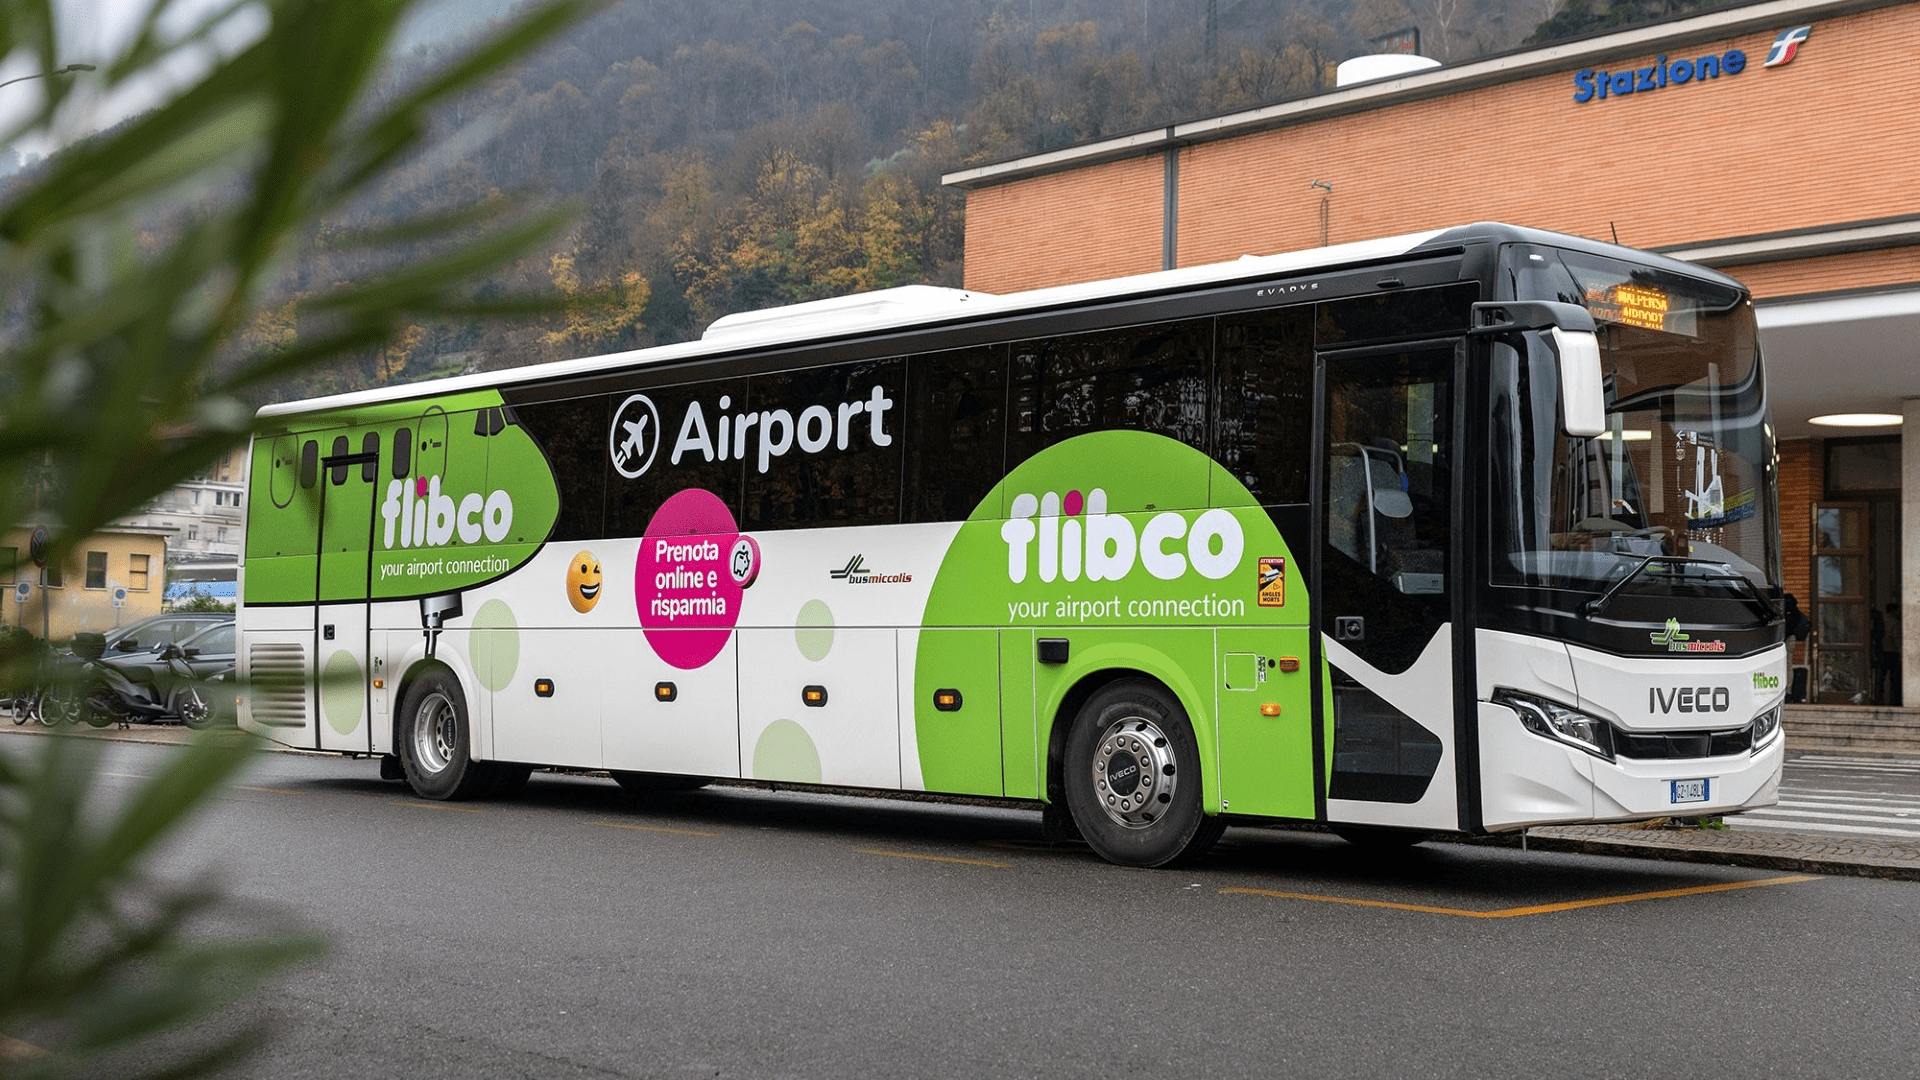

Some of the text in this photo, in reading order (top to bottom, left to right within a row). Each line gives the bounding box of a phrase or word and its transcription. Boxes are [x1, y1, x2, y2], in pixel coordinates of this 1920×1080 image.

[1573, 50, 1747, 103] Stazione
[671, 385, 893, 474] Airport
[381, 474, 513, 549] flibco
[1000, 488, 1245, 584] flibco
[655, 539, 719, 563] Prenota
[380, 554, 510, 581] your airport connection
[655, 564, 718, 590] online e
[848, 572, 912, 584] busmiccolis
[651, 590, 727, 621] risparmia
[1008, 593, 1245, 623] your airport connection
[1752, 671, 1779, 689] flibco
[1649, 687, 1730, 714] IVECO
[1109, 765, 1137, 782] IVECO
